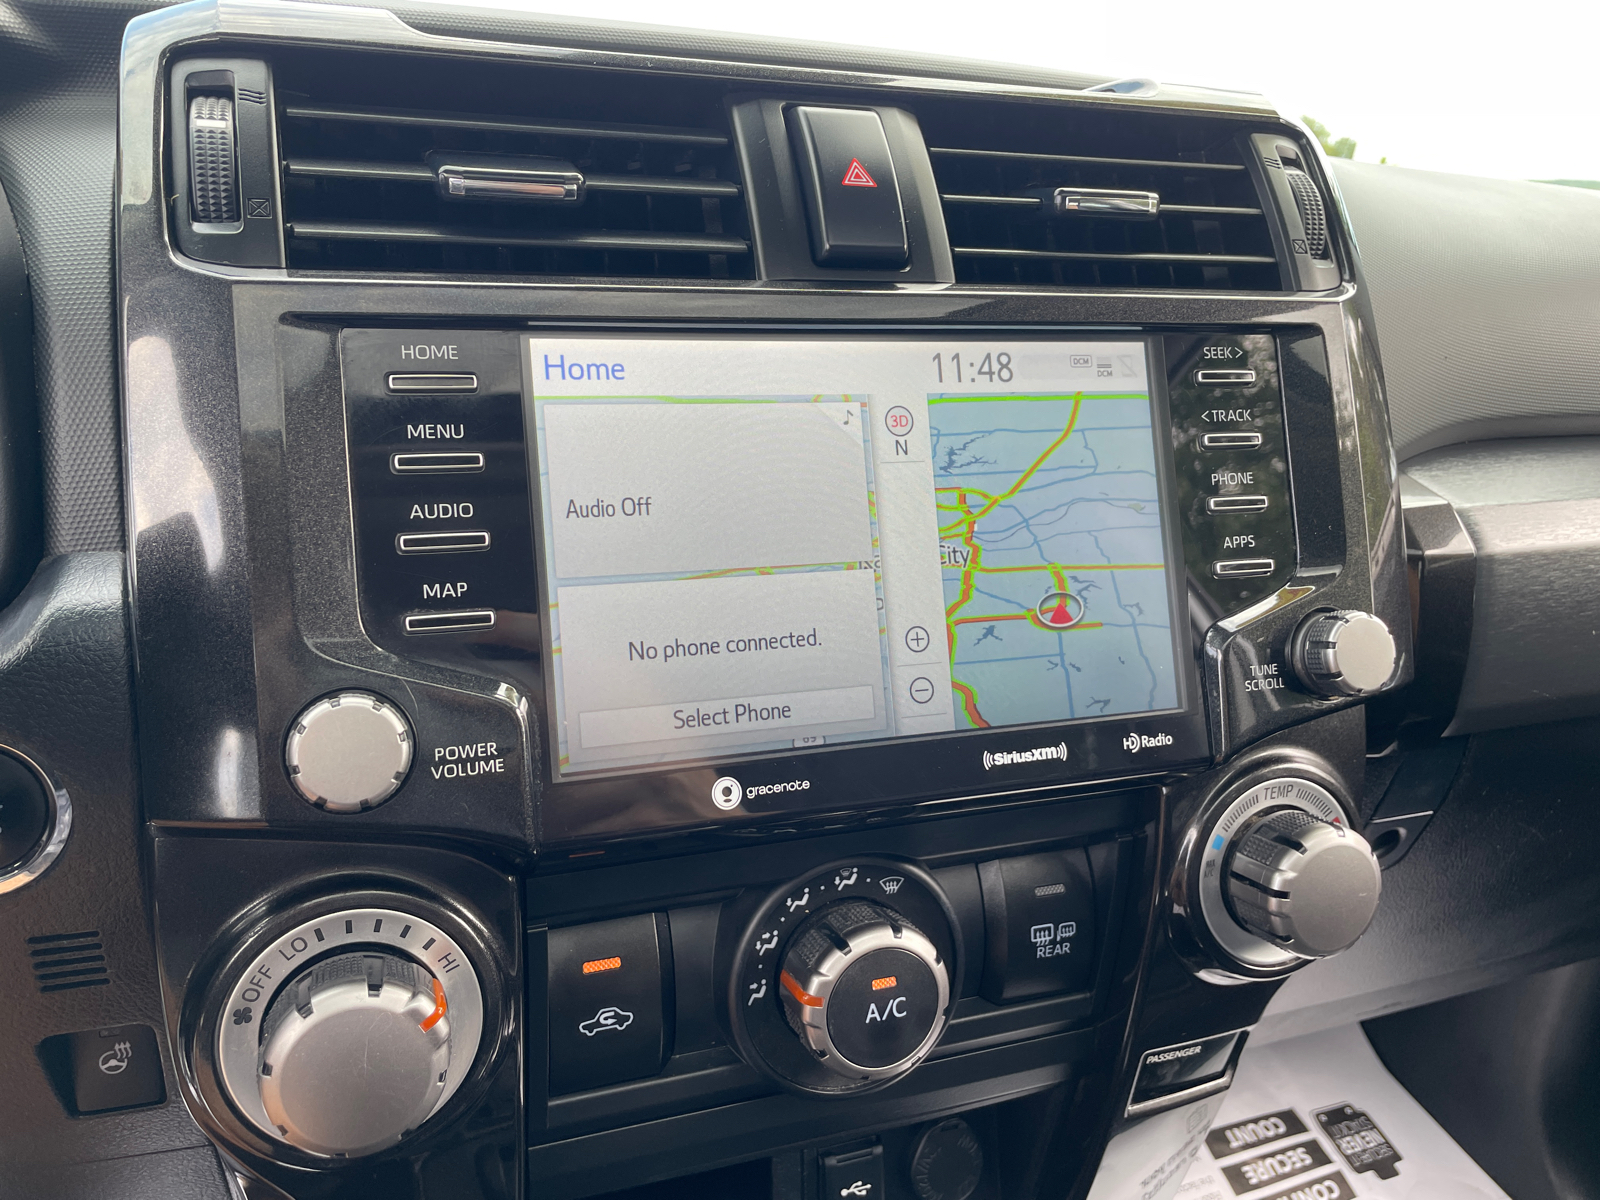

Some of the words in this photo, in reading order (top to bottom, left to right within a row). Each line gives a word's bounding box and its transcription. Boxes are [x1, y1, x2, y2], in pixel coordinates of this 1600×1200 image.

[401, 345, 458, 360] HOME
[1203, 347, 1233, 359] SEEK
[544, 354, 625, 380] Home
[932, 352, 1014, 383] 11:48
[890, 415, 909, 427] 3D
[1212, 409, 1252, 422] TRACK
[407, 424, 464, 439] MENU
[895, 440, 908, 455] N
[1211, 472, 1254, 485] PHONE
[410, 503, 474, 519] AUDIO
[566, 500, 616, 518] Audio
[621, 497, 652, 516] Off
[1223, 536, 1255, 549] APPS
[423, 582, 468, 598] MAP
[629, 641, 658, 661] No
[664, 636, 721, 662] phone
[726, 629, 822, 653] connected.
[1249, 663, 1278, 676] TUNE
[1244, 677, 1285, 692] SCROLL
[674, 708, 729, 729] Select
[735, 704, 792, 725] Phone
[1141, 732, 1173, 747] Radio
[434, 742, 498, 761] POWER
[431, 759, 505, 780] VOLUME
[746, 779, 810, 799] gracenote
[1264, 784, 1293, 800] TEMP
[278, 937, 308, 961] LO
[1036, 943, 1070, 958] REAR
[438, 953, 460, 974] HI
[241, 964, 272, 1003] OFF
[865, 997, 907, 1023] A/C
[1146, 1046, 1201, 1063] PASSENGER
[1225, 1117, 1287, 1148] COUNT
[1336, 1129, 1386, 1155] NEVER
[1241, 1147, 1313, 1185] SECURE
